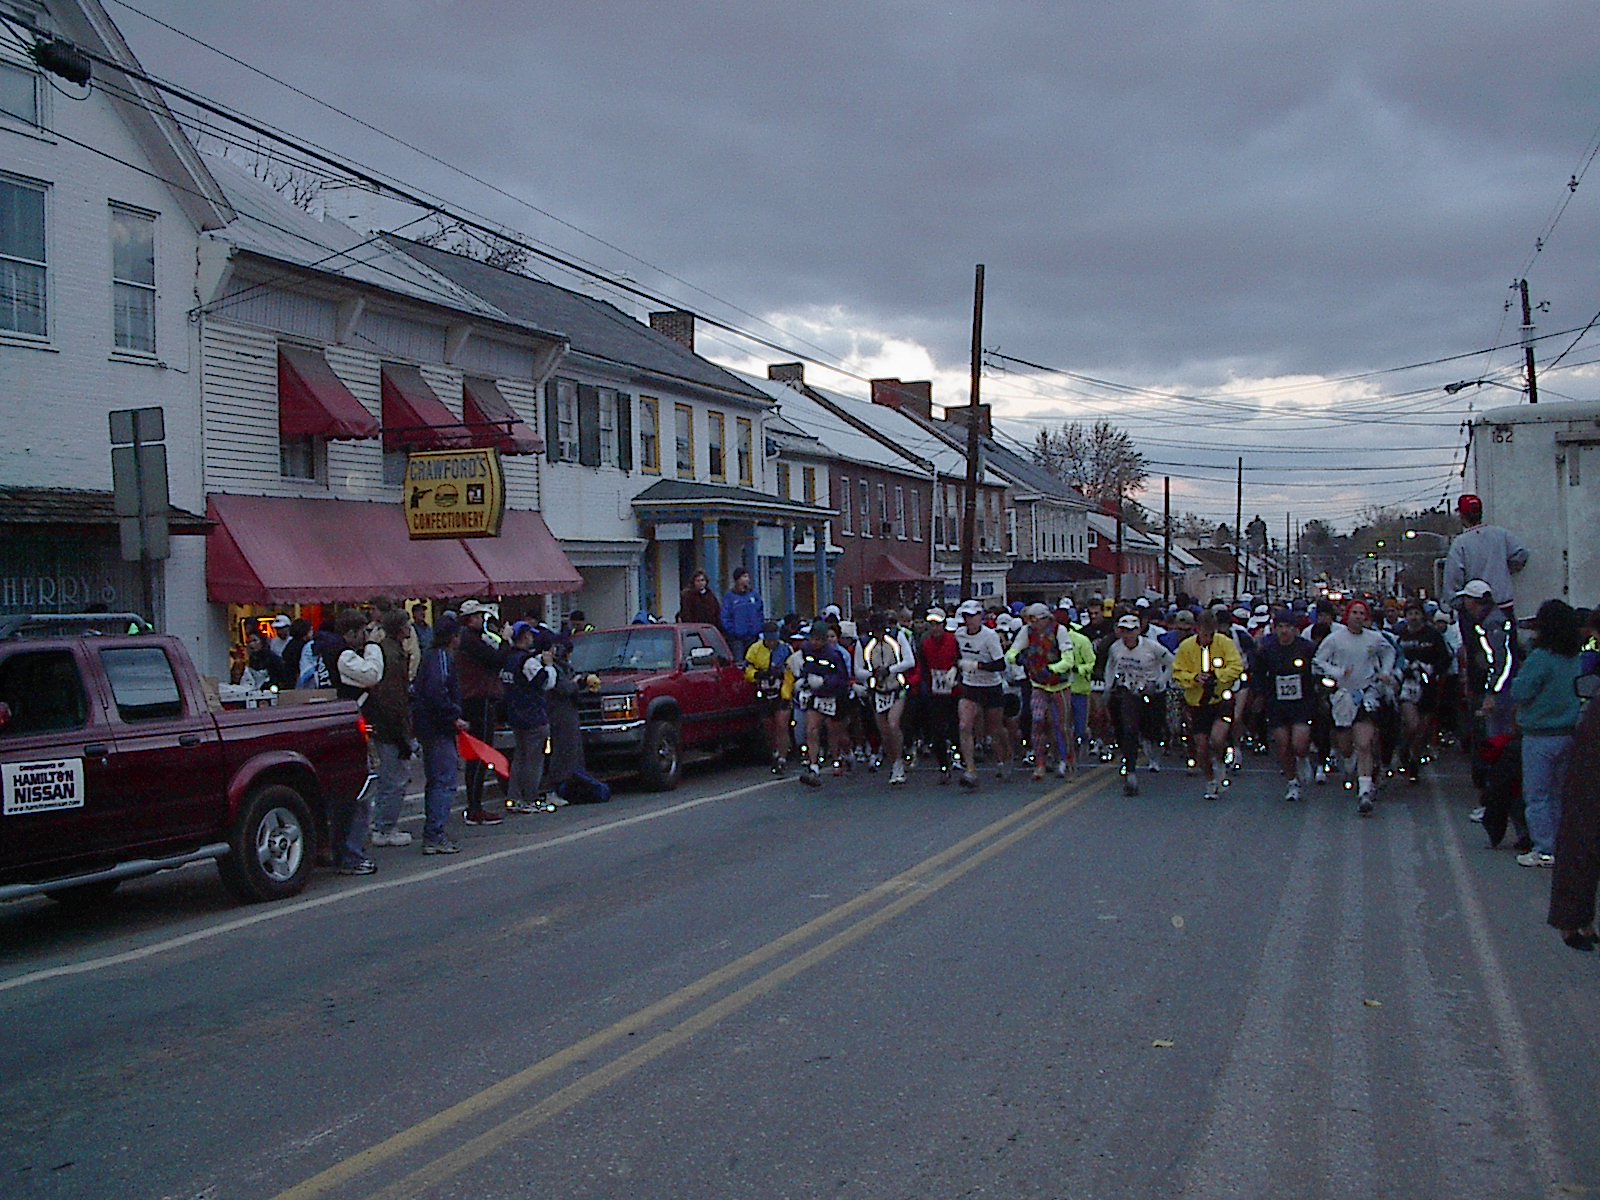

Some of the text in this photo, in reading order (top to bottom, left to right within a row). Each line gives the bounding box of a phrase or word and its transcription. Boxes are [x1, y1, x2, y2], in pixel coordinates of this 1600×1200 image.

[409, 456, 487, 481] CRAWFORD'S
[413, 511, 485, 530] CONFECTIONERY
[13, 770, 74, 787] HAMILTON
[14, 783, 75, 804] NISSAN
